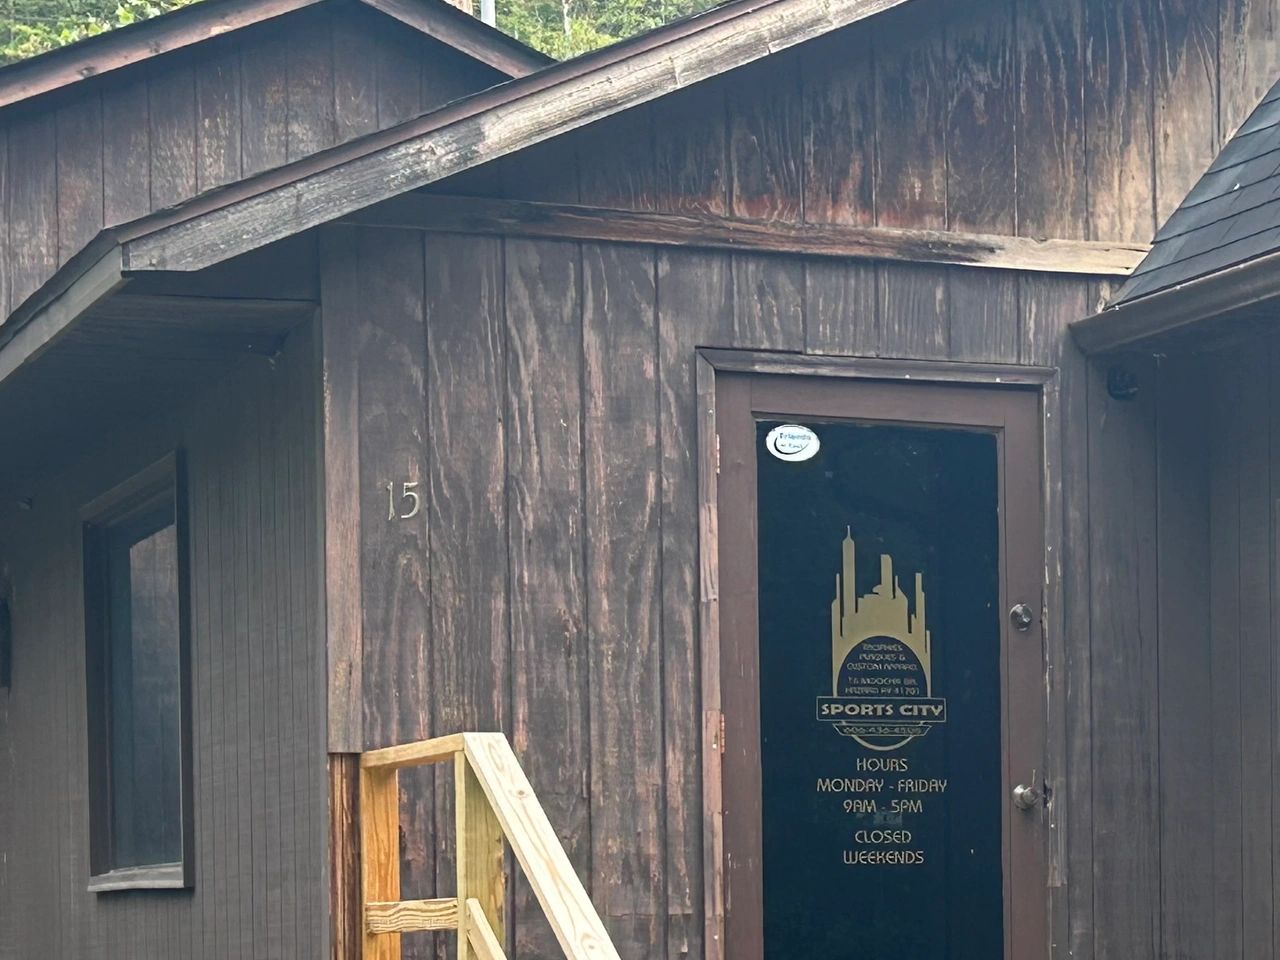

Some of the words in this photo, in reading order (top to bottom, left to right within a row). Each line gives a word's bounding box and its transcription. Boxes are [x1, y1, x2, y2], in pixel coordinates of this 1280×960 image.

[386, 481, 420, 520] 15
[821, 703, 894, 716] SPORTS
[899, 704, 944, 716] CITY
[856, 758, 908, 772] HOURS
[816, 778, 884, 793] MONDAY
[897, 779, 948, 793] FRIDAY
[843, 799, 877, 813] 9AM
[891, 799, 923, 813] 5PM
[854, 830, 912, 844] CLOSED
[843, 850, 925, 864] WEEKENDS
